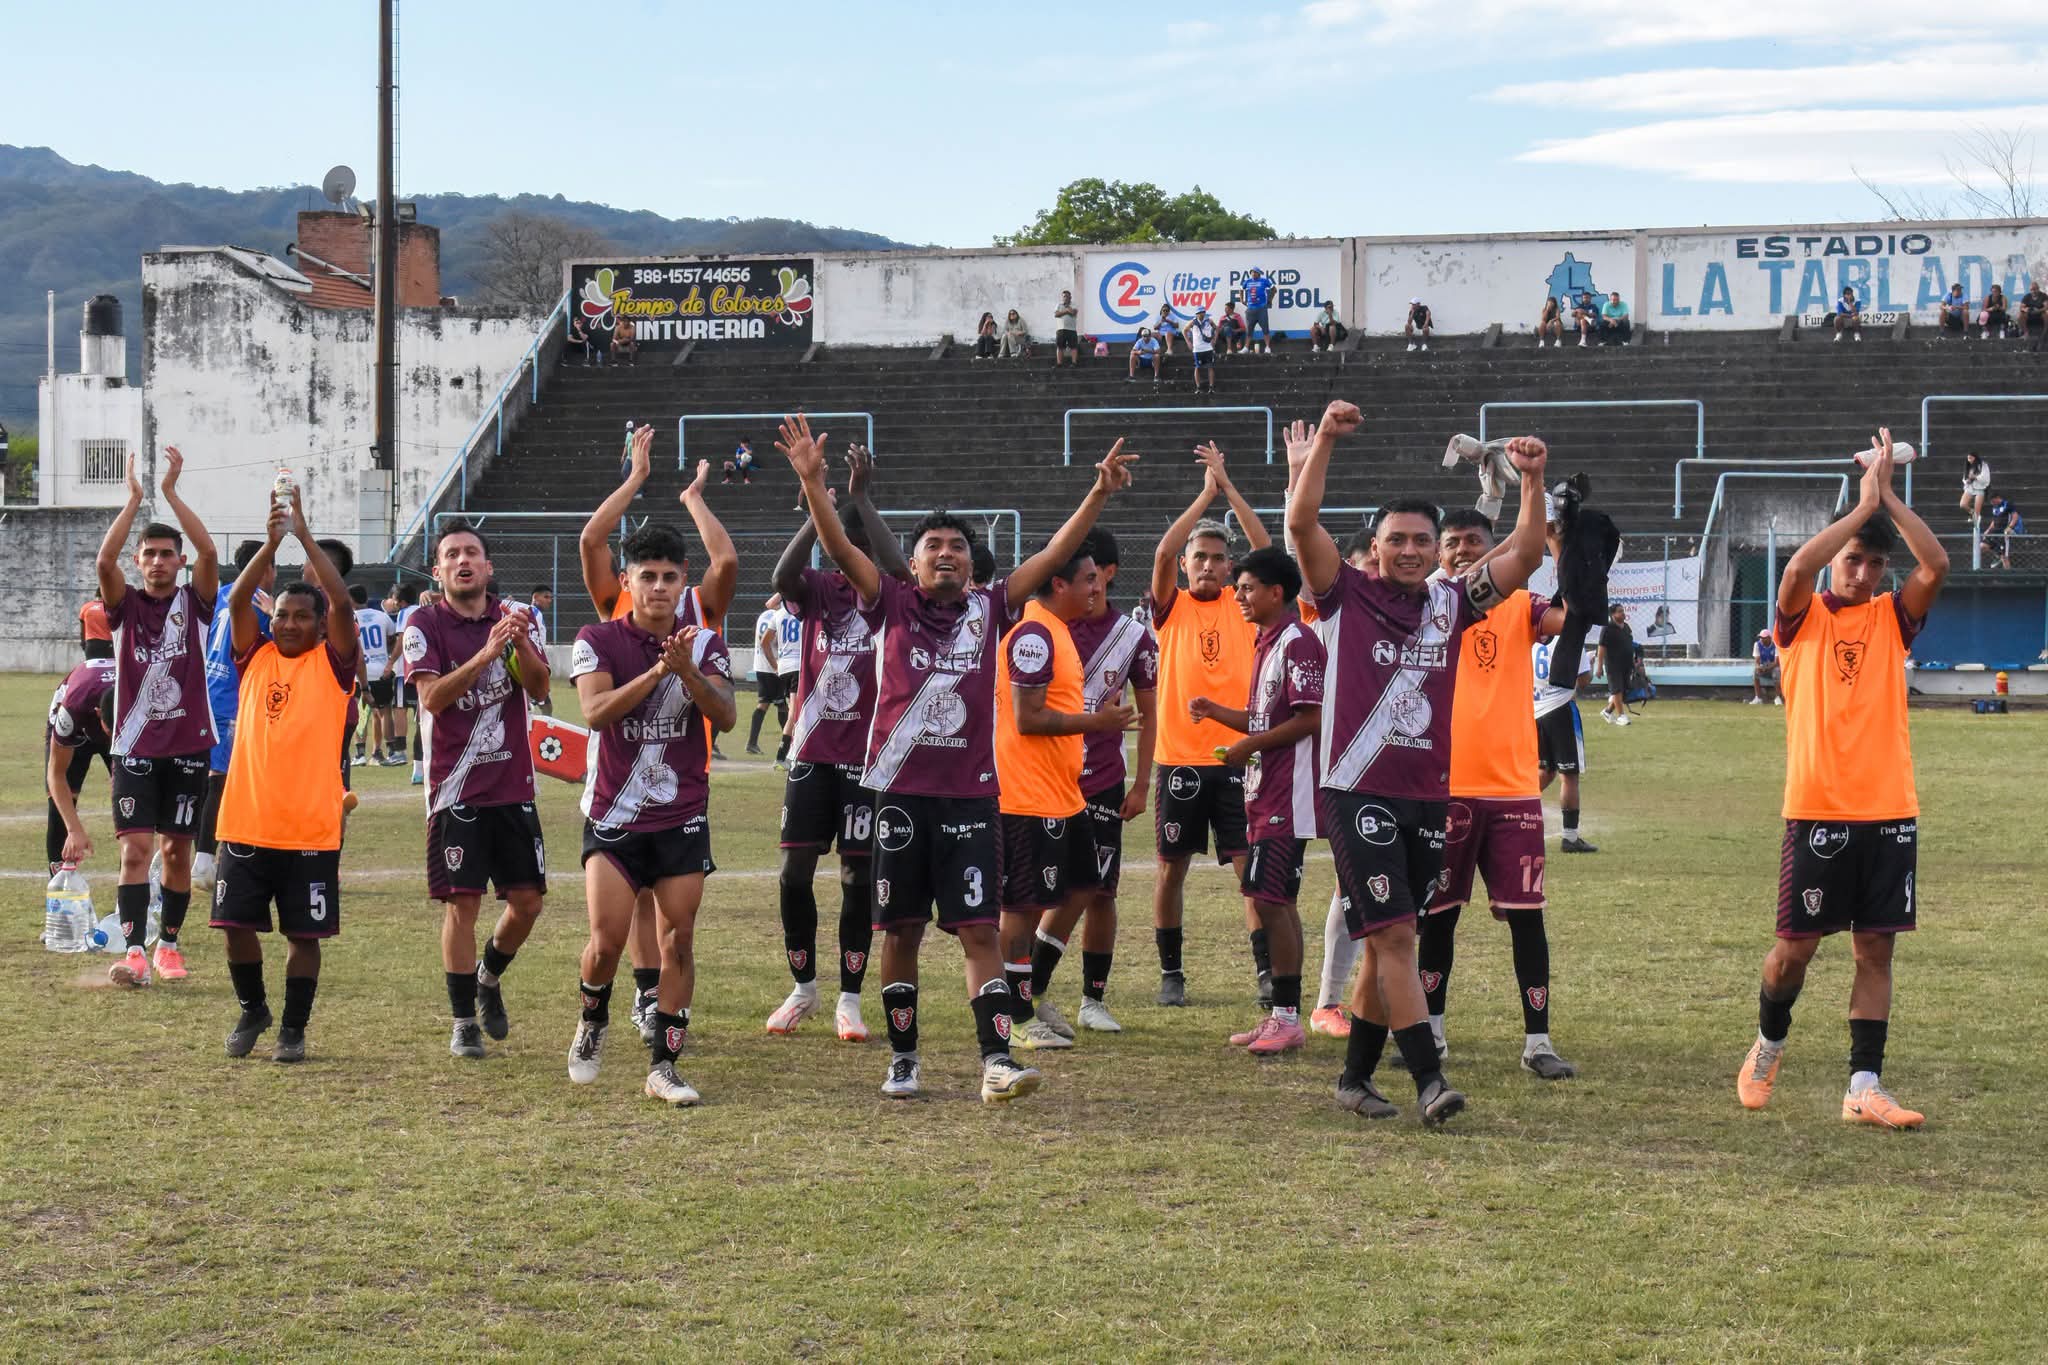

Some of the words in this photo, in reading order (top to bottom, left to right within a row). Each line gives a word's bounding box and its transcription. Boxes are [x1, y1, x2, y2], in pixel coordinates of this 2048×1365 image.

[1736, 233, 1932, 259] ESTADIO
[634, 267, 751, 285] 388-155744656
[1172, 272, 1221, 291] fiber
[1230, 270, 1277, 286] PAK
[1280, 272, 1297, 283] HD
[1661, 262, 1734, 317] LA
[1758, 254, 2031, 315] TABLADA
[611, 286, 677, 319] Tiempo
[679, 285, 705, 316] de
[710, 284, 788, 316] Colores
[1172, 291, 1217, 313] way
[1230, 287, 1326, 309] FBOL
[635, 318, 765, 341] INTURERIA
[360, 624, 383, 650] 10
[781, 618, 800, 644] 18
[1019, 648, 1043, 660] Nahir
[1401, 645, 1448, 668] NELI
[643, 717, 688, 740] NELI
[911, 735, 944, 747] SANTA
[944, 737, 968, 748] RITA
[1381, 735, 1414, 747] SANTA
[843, 804, 873, 841] 18
[941, 824, 957, 834] The
[1094, 813, 1110, 823] One
[1520, 821, 1537, 830] One
[683, 825, 701, 834] One
[1429, 840, 1443, 849] One
[963, 866, 983, 907] 3
[309, 882, 327, 921] 5
